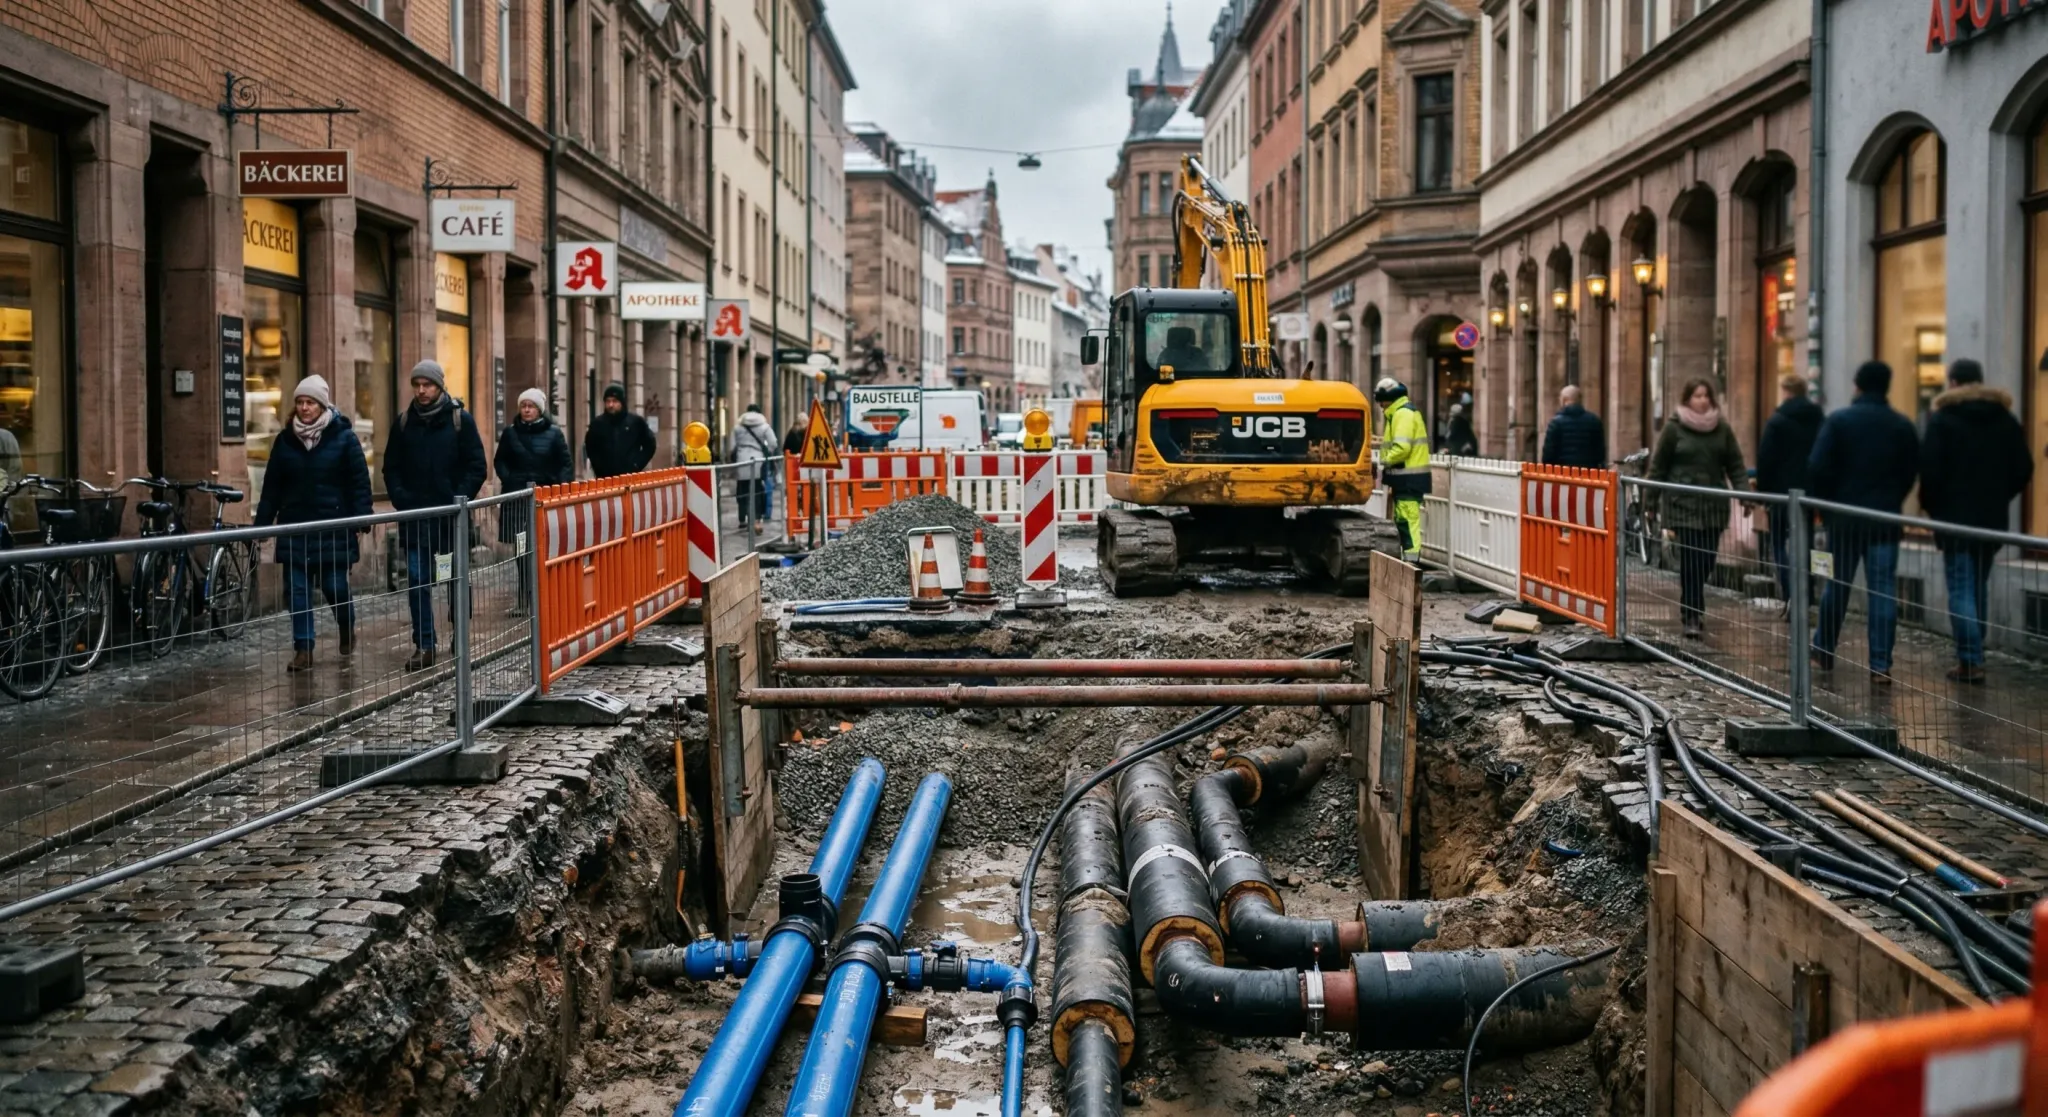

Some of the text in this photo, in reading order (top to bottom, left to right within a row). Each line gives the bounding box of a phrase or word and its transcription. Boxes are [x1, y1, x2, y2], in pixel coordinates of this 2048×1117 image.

[244, 160, 344, 183] BÄCKEREI
[441, 211, 504, 237] CAFÉ
[626, 294, 699, 307] APOTHEKE
[852, 391, 920, 404] BAUSTELLE
[1231, 416, 1307, 439] JCB
